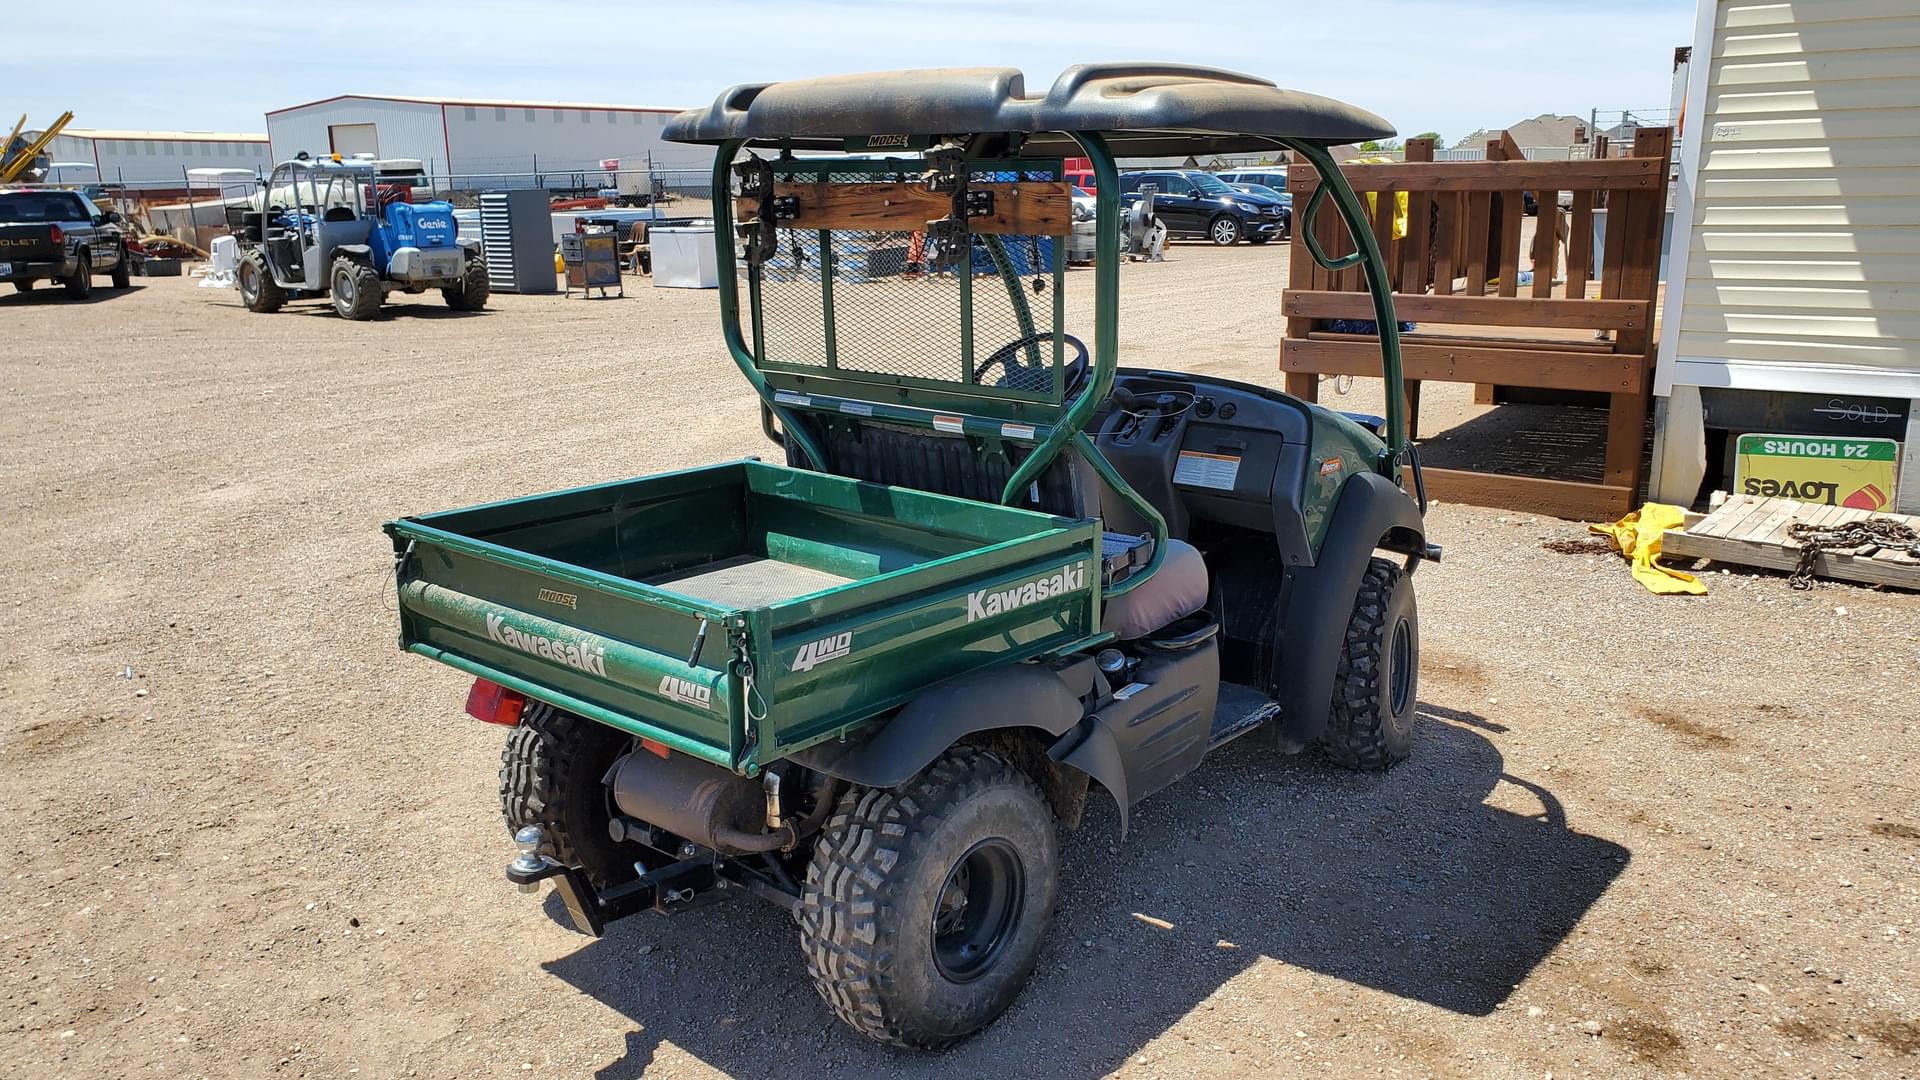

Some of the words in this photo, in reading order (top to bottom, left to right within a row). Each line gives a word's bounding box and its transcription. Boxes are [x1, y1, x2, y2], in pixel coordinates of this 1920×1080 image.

[868, 134, 910, 147] MOOSE
[418, 218, 448, 229] Genie
[1827, 399, 1889, 424] SOLD
[1764, 440, 1837, 457] HOURS
[1843, 445, 1869, 458] 24
[538, 588, 577, 610] MOOSE
[967, 560, 1084, 623] Kawasaki
[486, 612, 607, 678] Kawasaki
[791, 631, 853, 672] 4WD
[659, 675, 711, 702] 4WD
